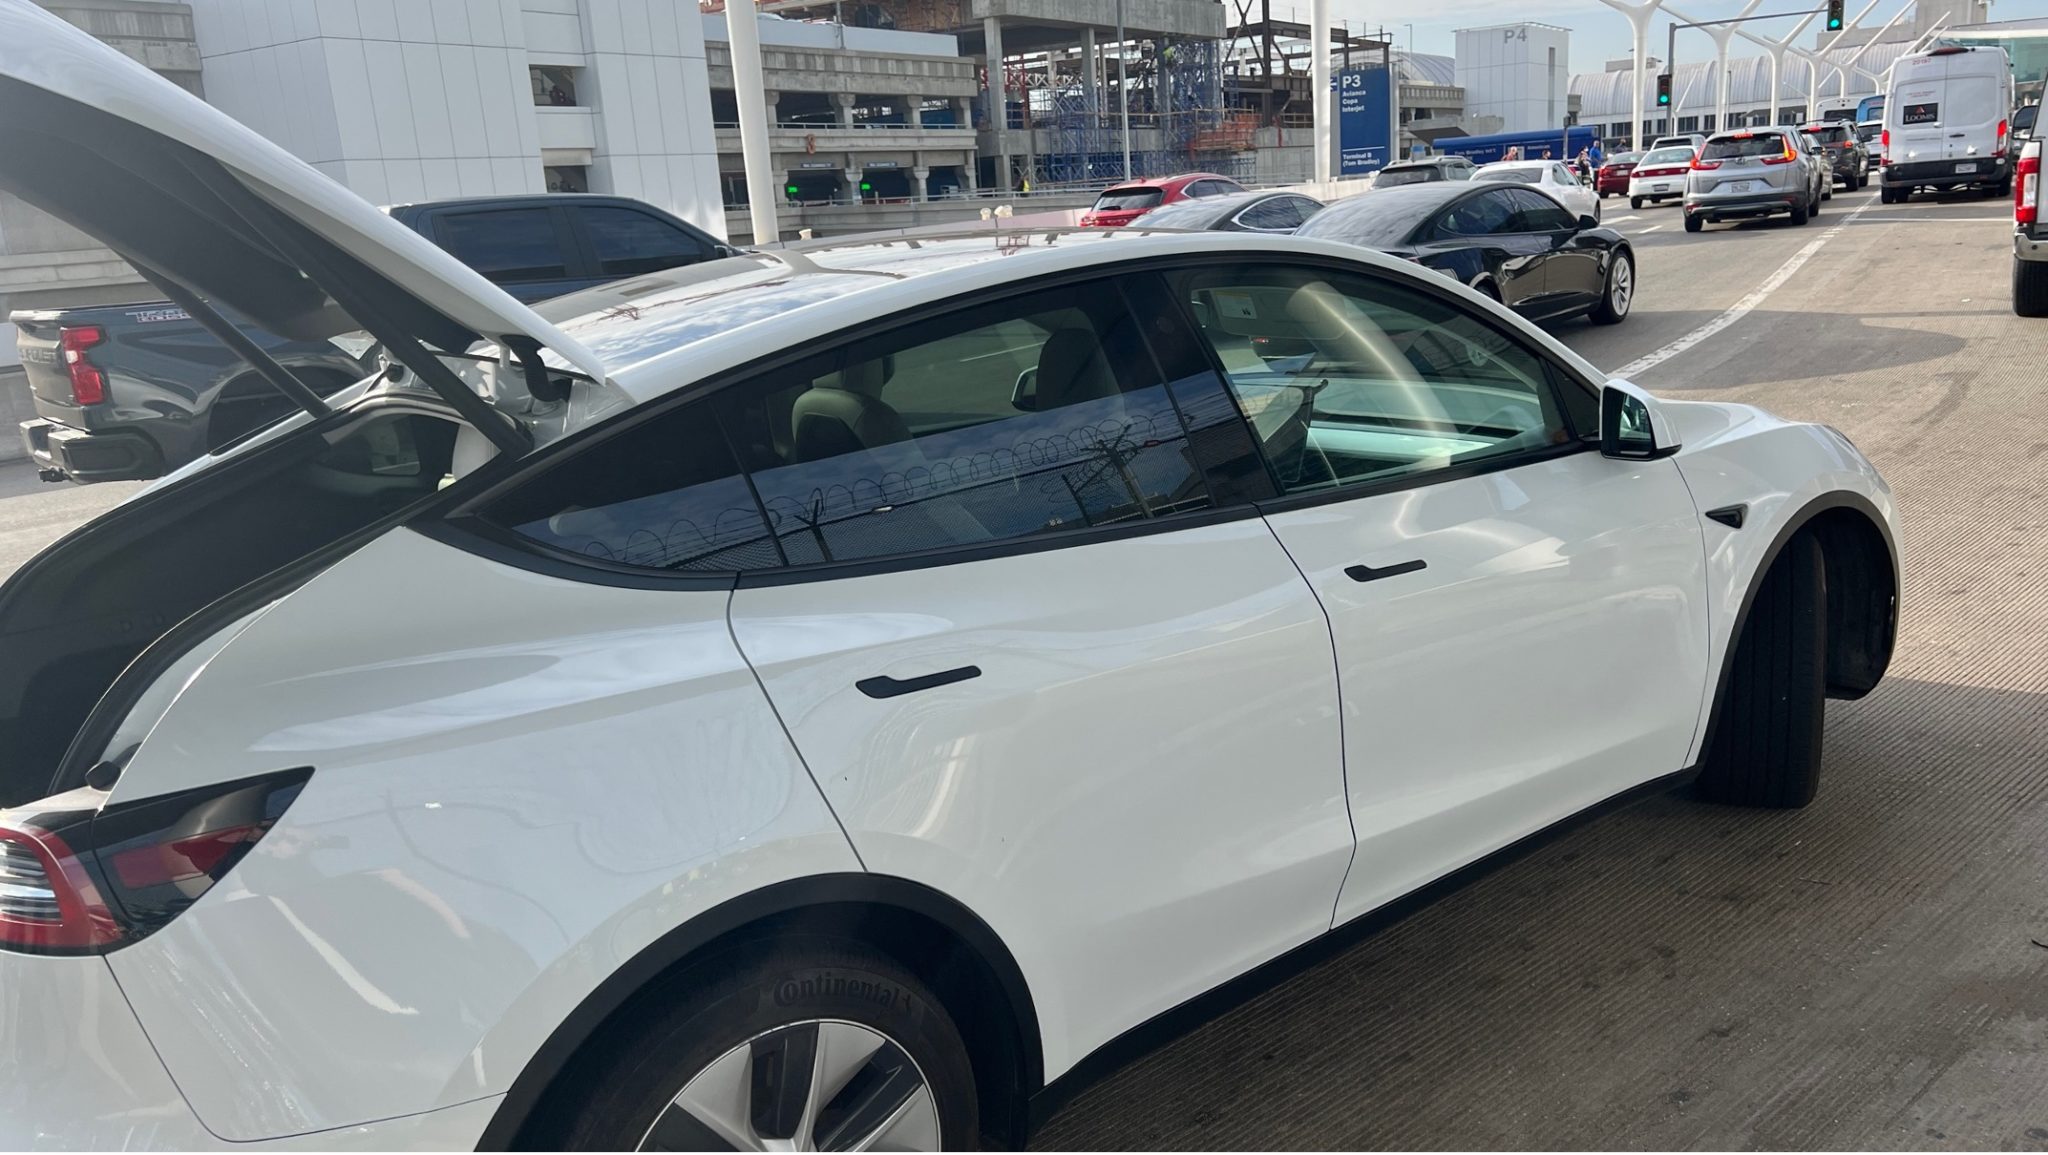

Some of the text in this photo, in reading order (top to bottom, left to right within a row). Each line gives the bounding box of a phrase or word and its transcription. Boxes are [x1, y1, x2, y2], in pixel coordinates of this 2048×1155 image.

[1504, 28, 1527, 44] P4
[1342, 75, 1361, 88] P3
[1343, 152, 1366, 160] Terminal
[773, 971, 900, 1007] Continental
